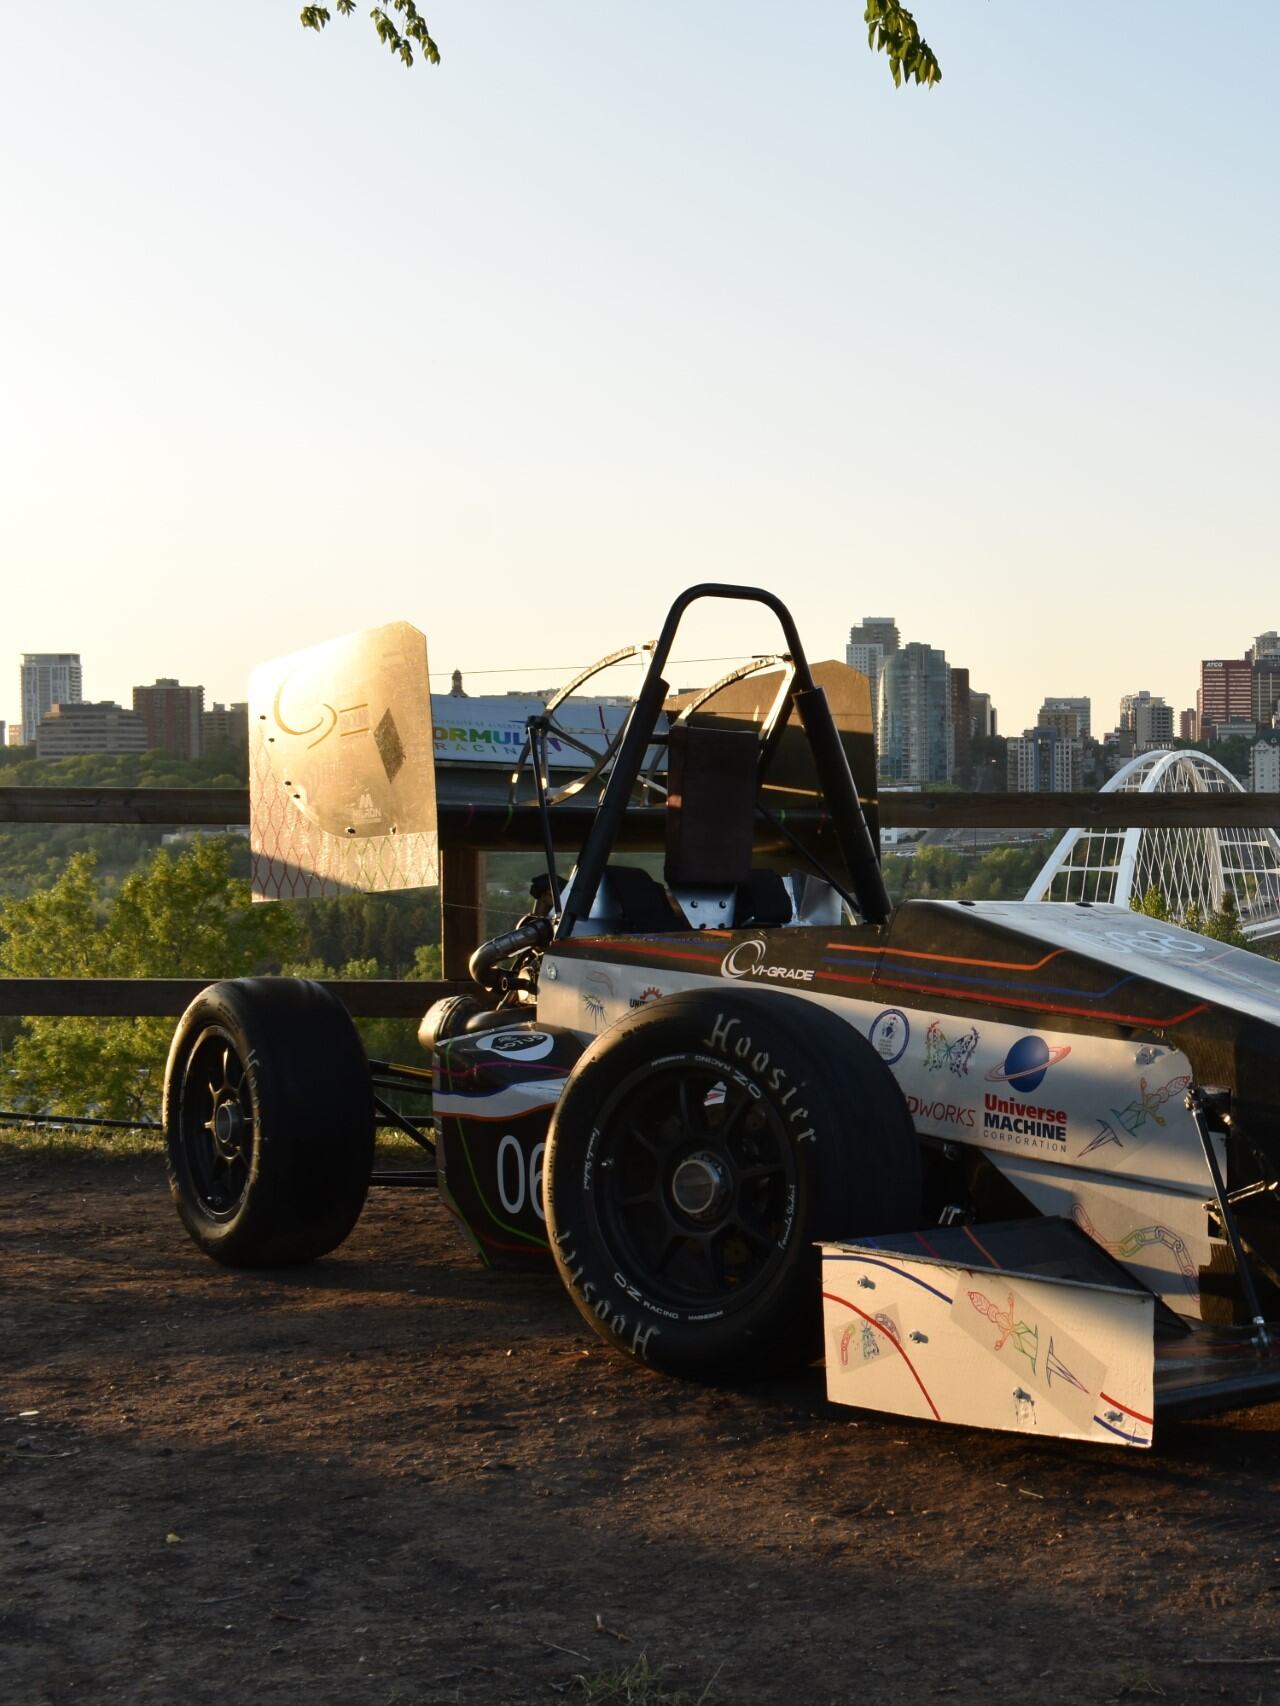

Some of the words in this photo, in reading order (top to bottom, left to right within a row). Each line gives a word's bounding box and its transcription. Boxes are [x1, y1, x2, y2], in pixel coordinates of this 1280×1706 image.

[434, 742, 518, 755] RACIN
[496, 1035, 544, 1050] LOTUS
[704, 1013, 817, 1142] Hoosier
[907, 1096, 976, 1127] DWORKS
[984, 1093, 1068, 1124] Universe
[983, 1130, 1067, 1152] CORPORATION
[984, 1112, 1067, 1142] MACHINE
[497, 1135, 545, 1221] 06
[643, 1301, 679, 1320] RACING
